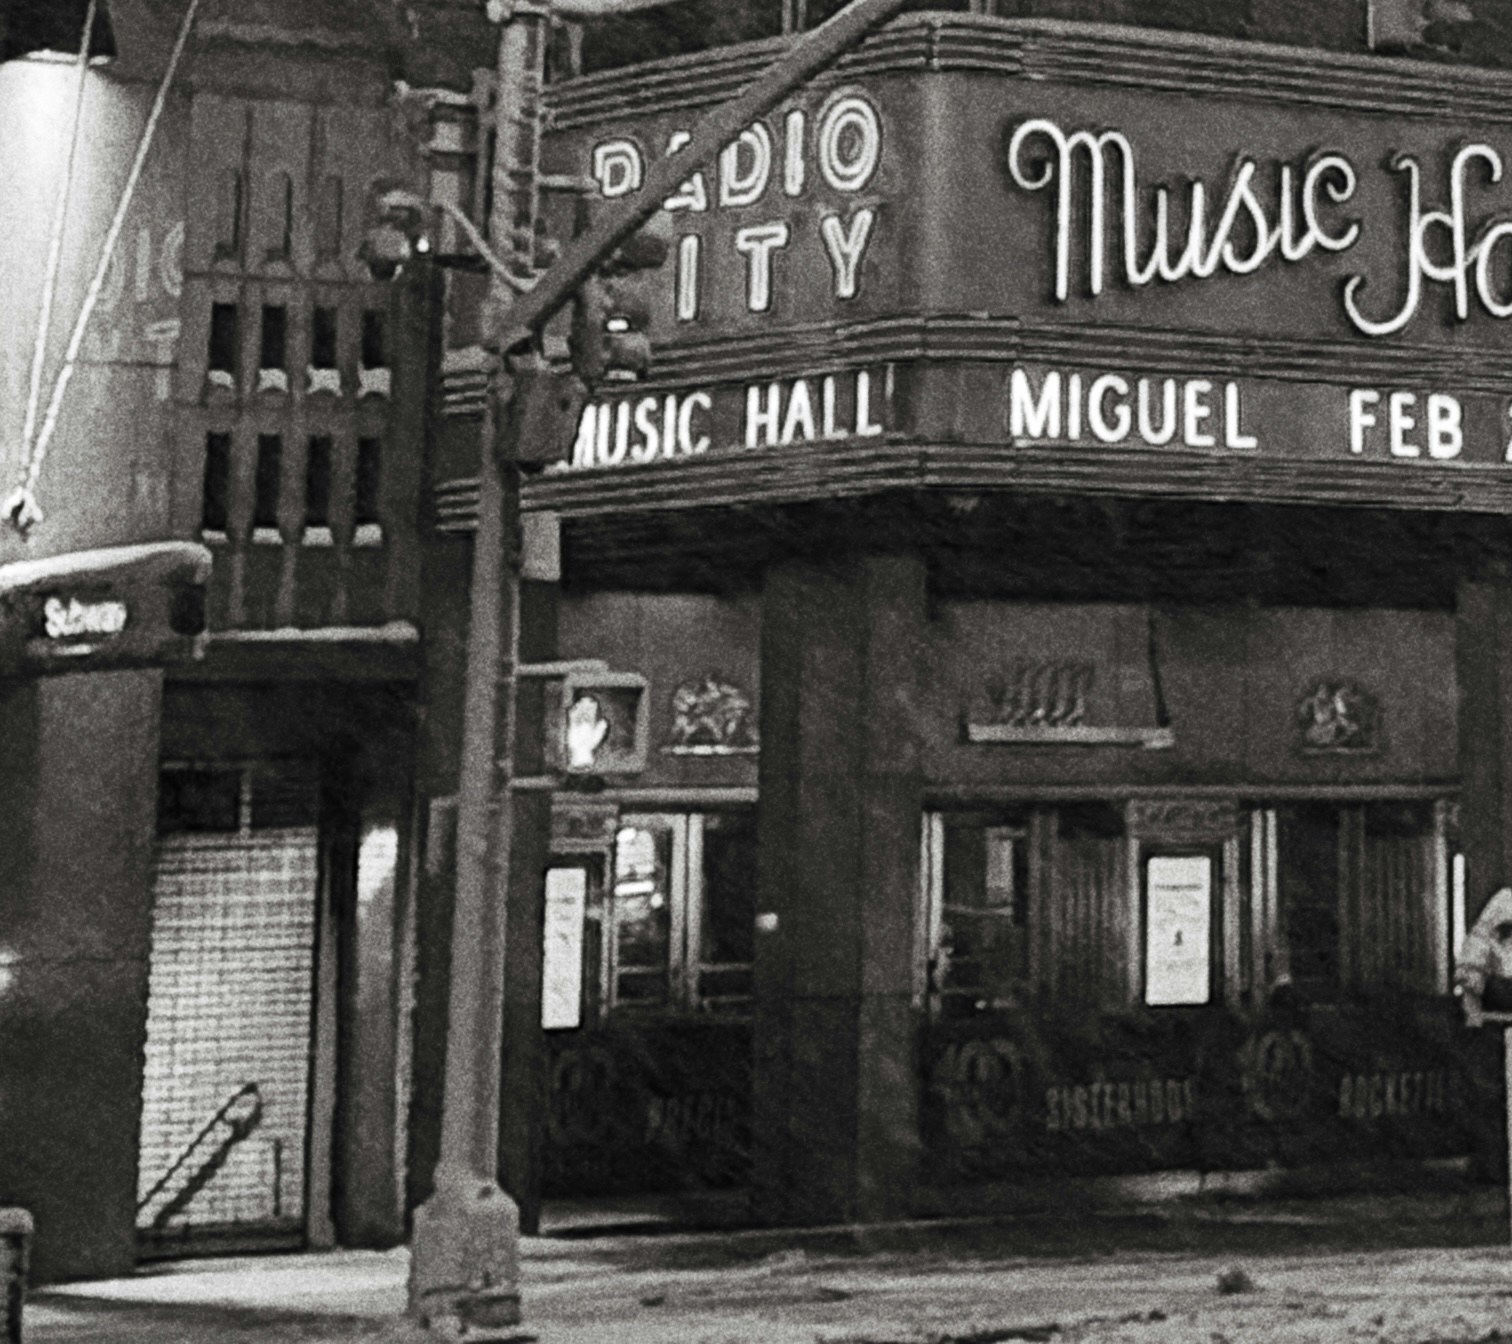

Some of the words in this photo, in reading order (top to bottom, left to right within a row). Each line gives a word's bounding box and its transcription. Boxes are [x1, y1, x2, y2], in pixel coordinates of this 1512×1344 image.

[1009, 118, 1360, 300] Music
[675, 208, 873, 322] ITY
[746, 371, 882, 449] HALL
[1011, 369, 1258, 449] MIGUEL
[1348, 389, 1463, 465] FEB
